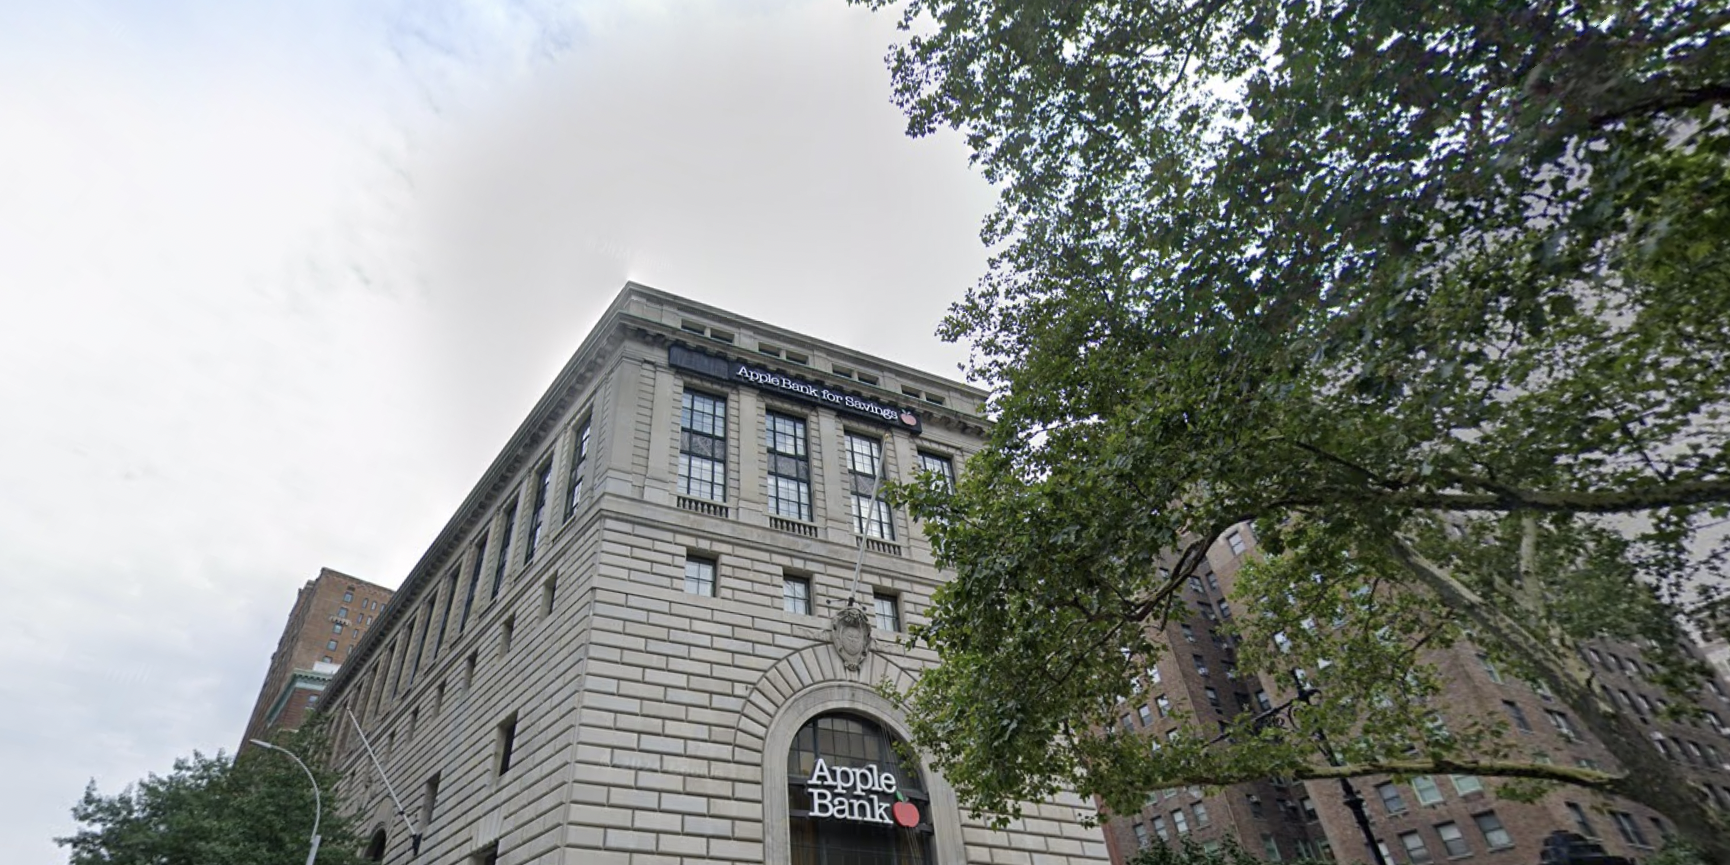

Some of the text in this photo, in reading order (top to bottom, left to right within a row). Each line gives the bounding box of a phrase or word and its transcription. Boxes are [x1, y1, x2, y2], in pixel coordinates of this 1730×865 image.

[736, 365, 898, 420] Apple Bank for Savings
[807, 758, 897, 795] Apple
[807, 787, 894, 824] Bank
